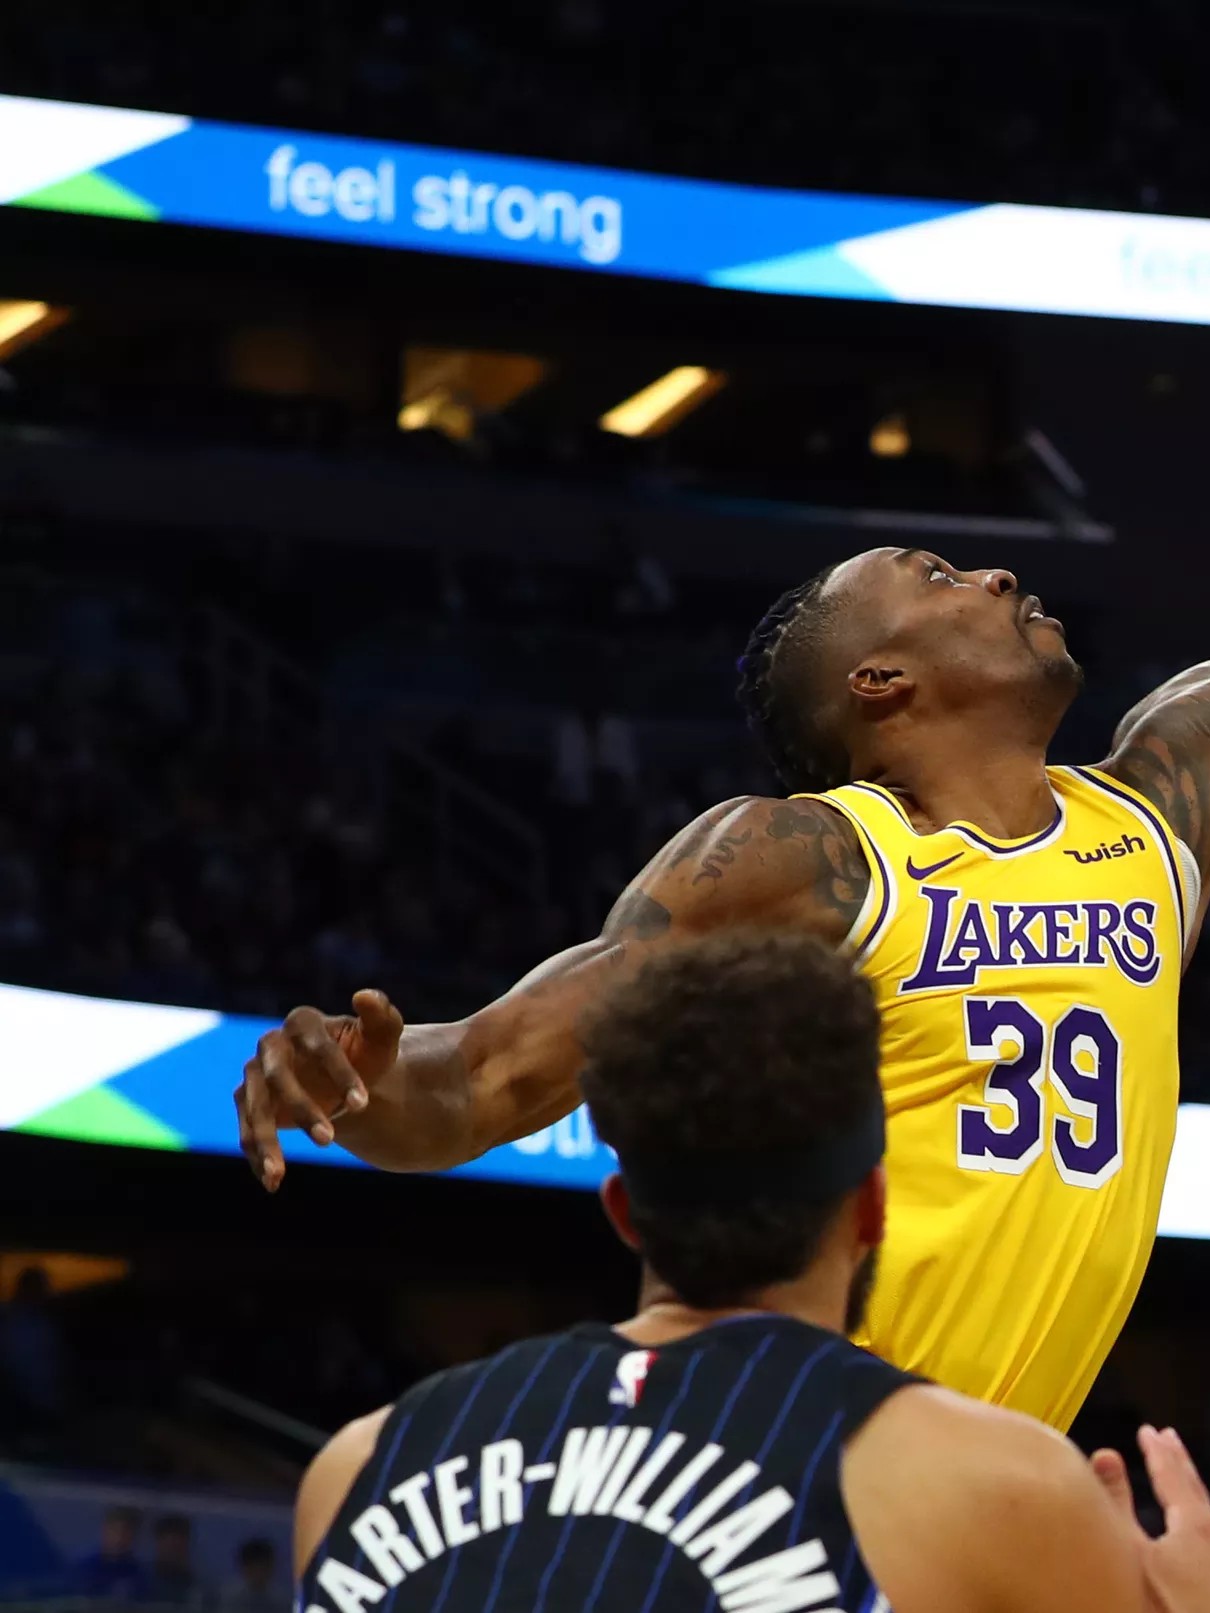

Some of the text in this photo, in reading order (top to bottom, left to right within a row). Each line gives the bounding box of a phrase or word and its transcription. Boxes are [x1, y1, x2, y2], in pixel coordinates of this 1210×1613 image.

[264, 143, 622, 265] feel strong
[1064, 834, 1145, 864] wish
[897, 884, 1161, 994] LAKERS
[957, 995, 1124, 1190] 39
[304, 1425, 847, 1613] ARTER-WILLIAM
